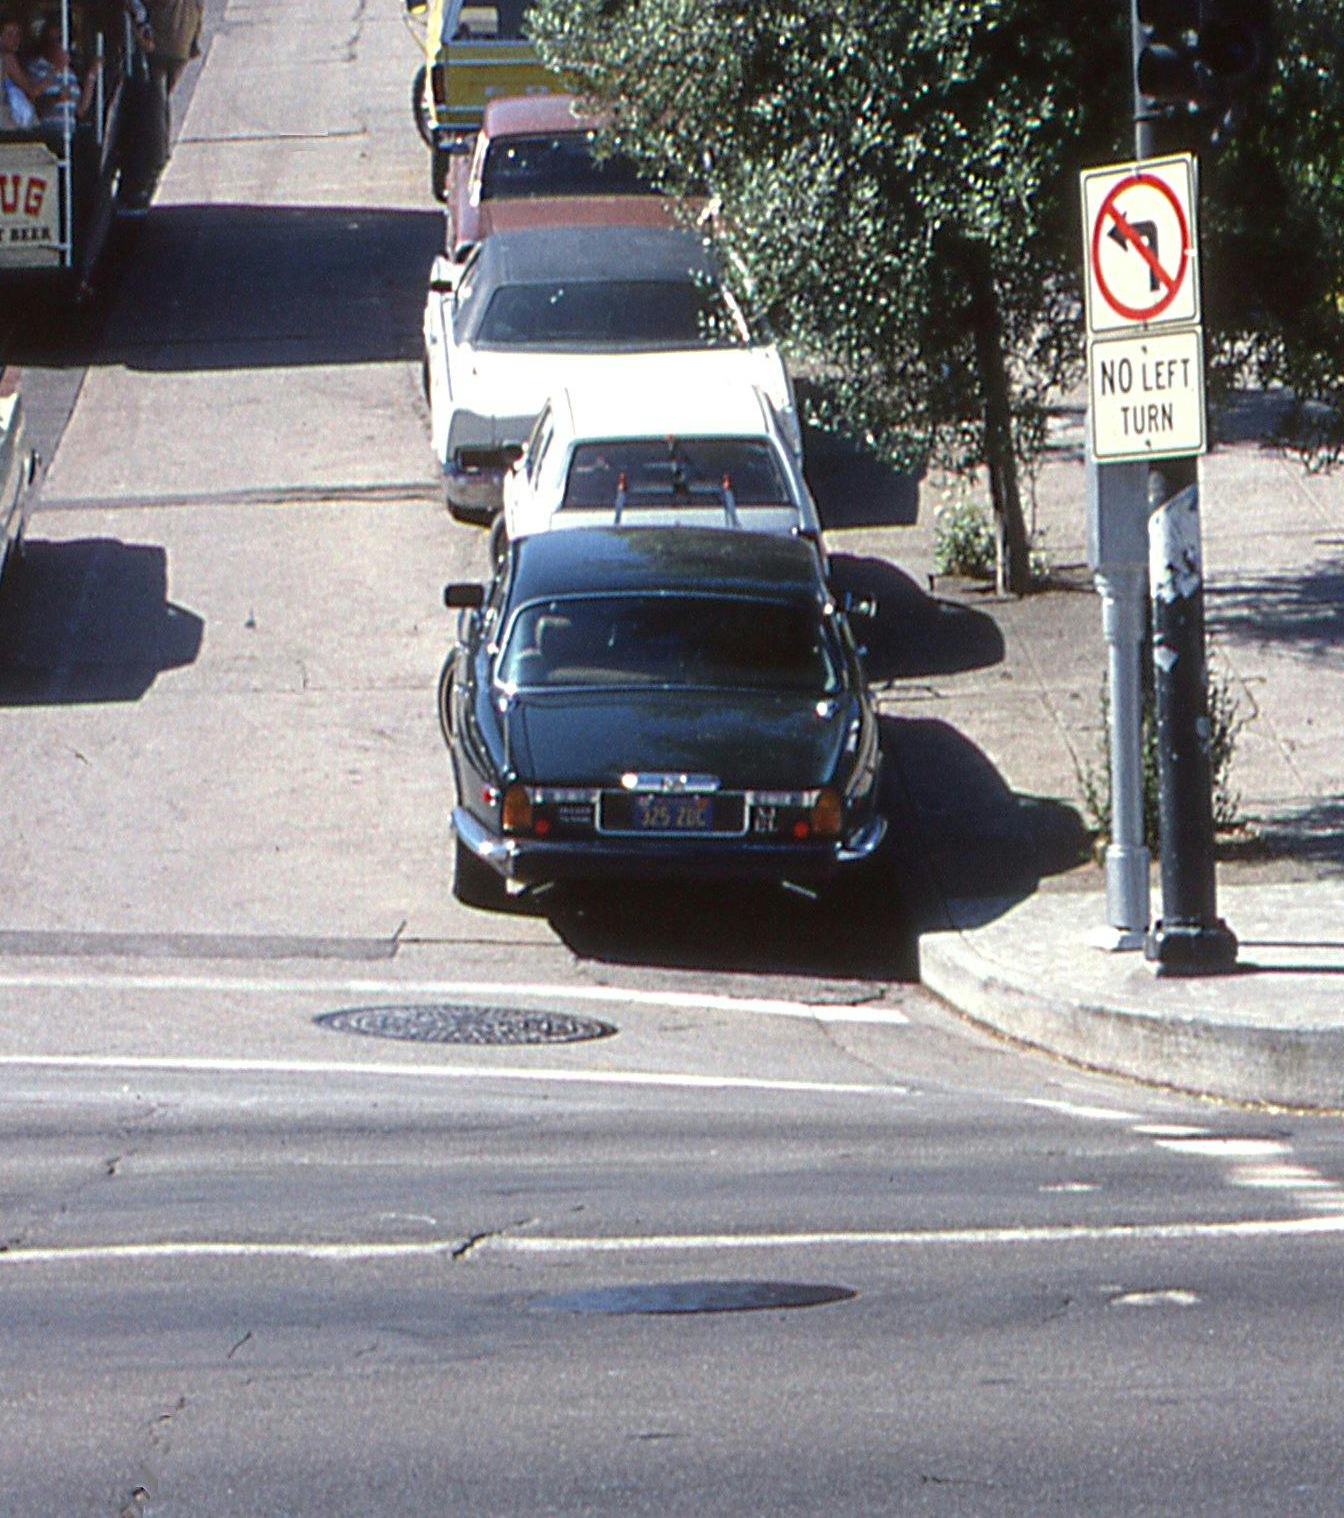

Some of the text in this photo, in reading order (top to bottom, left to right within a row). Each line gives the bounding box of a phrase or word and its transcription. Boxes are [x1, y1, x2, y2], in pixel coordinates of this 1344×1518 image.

[9, 226, 51, 242] BEER
[1100, 357, 1191, 396] NO LEFT
[1120, 402, 1174, 436] TURN
